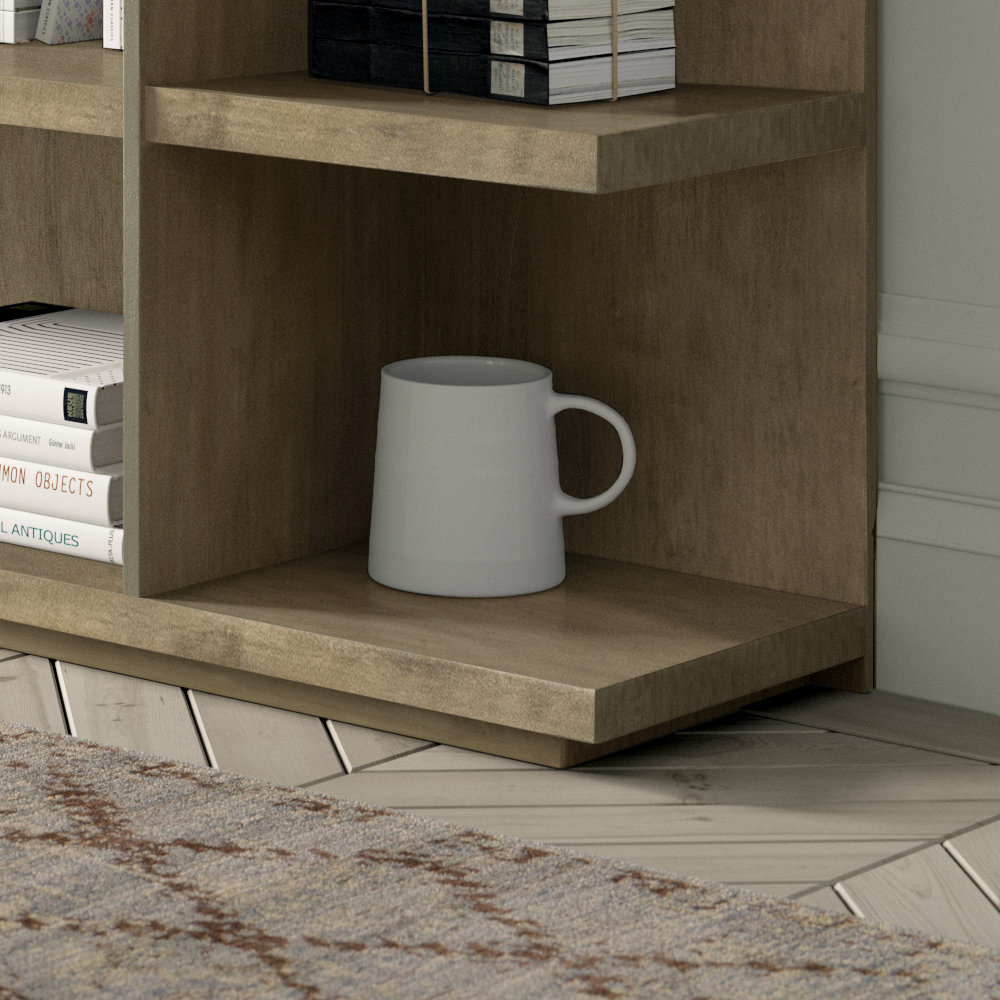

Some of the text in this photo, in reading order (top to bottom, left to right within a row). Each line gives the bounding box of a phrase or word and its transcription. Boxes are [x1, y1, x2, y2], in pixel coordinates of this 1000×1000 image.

[2, 430, 42, 446] ARGUMENT
[34, 470, 94, 498] OBJECTS
[11, 523, 80, 548] ANTIQUES
